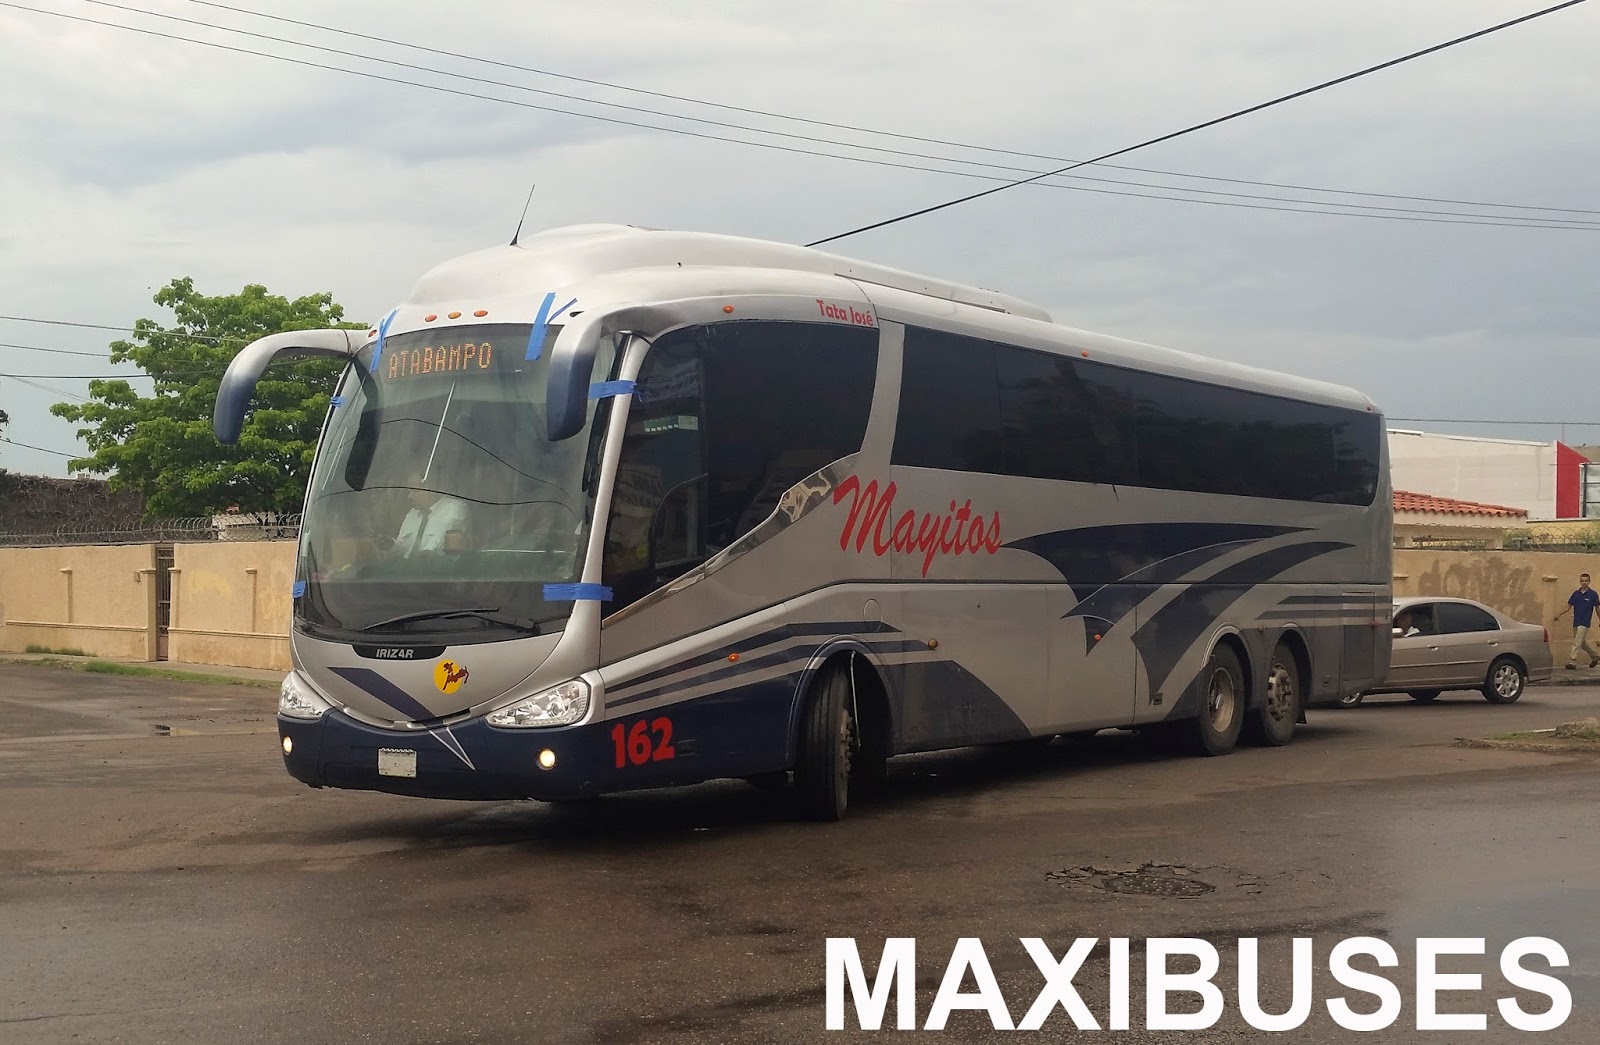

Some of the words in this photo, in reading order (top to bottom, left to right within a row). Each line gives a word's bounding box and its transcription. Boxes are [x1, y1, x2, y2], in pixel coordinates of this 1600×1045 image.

[816, 299, 847, 321] Tata
[849, 306, 874, 326] José
[388, 342, 492, 378] ATABAMPO
[833, 474, 1003, 578] Mayitos
[375, 648, 414, 659] IRIZAR
[611, 716, 676, 769] 162
